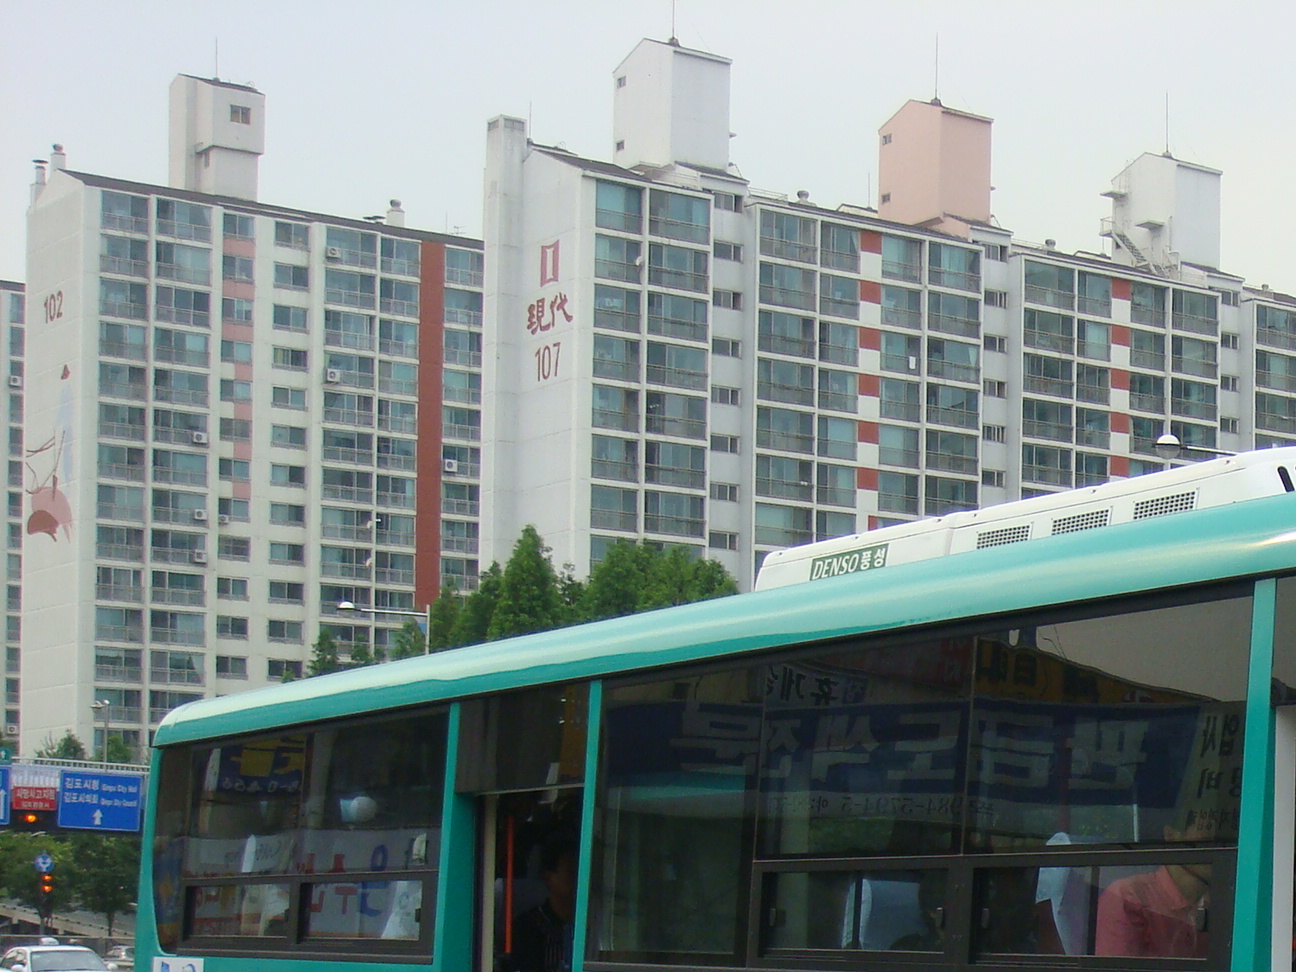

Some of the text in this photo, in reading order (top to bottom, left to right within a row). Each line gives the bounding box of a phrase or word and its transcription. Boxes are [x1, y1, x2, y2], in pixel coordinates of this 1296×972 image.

[44, 290, 63, 324] 102
[527, 292, 573, 335] 現代
[535, 342, 561, 382] 107
[812, 547, 886, 581] DENSO 풍성
